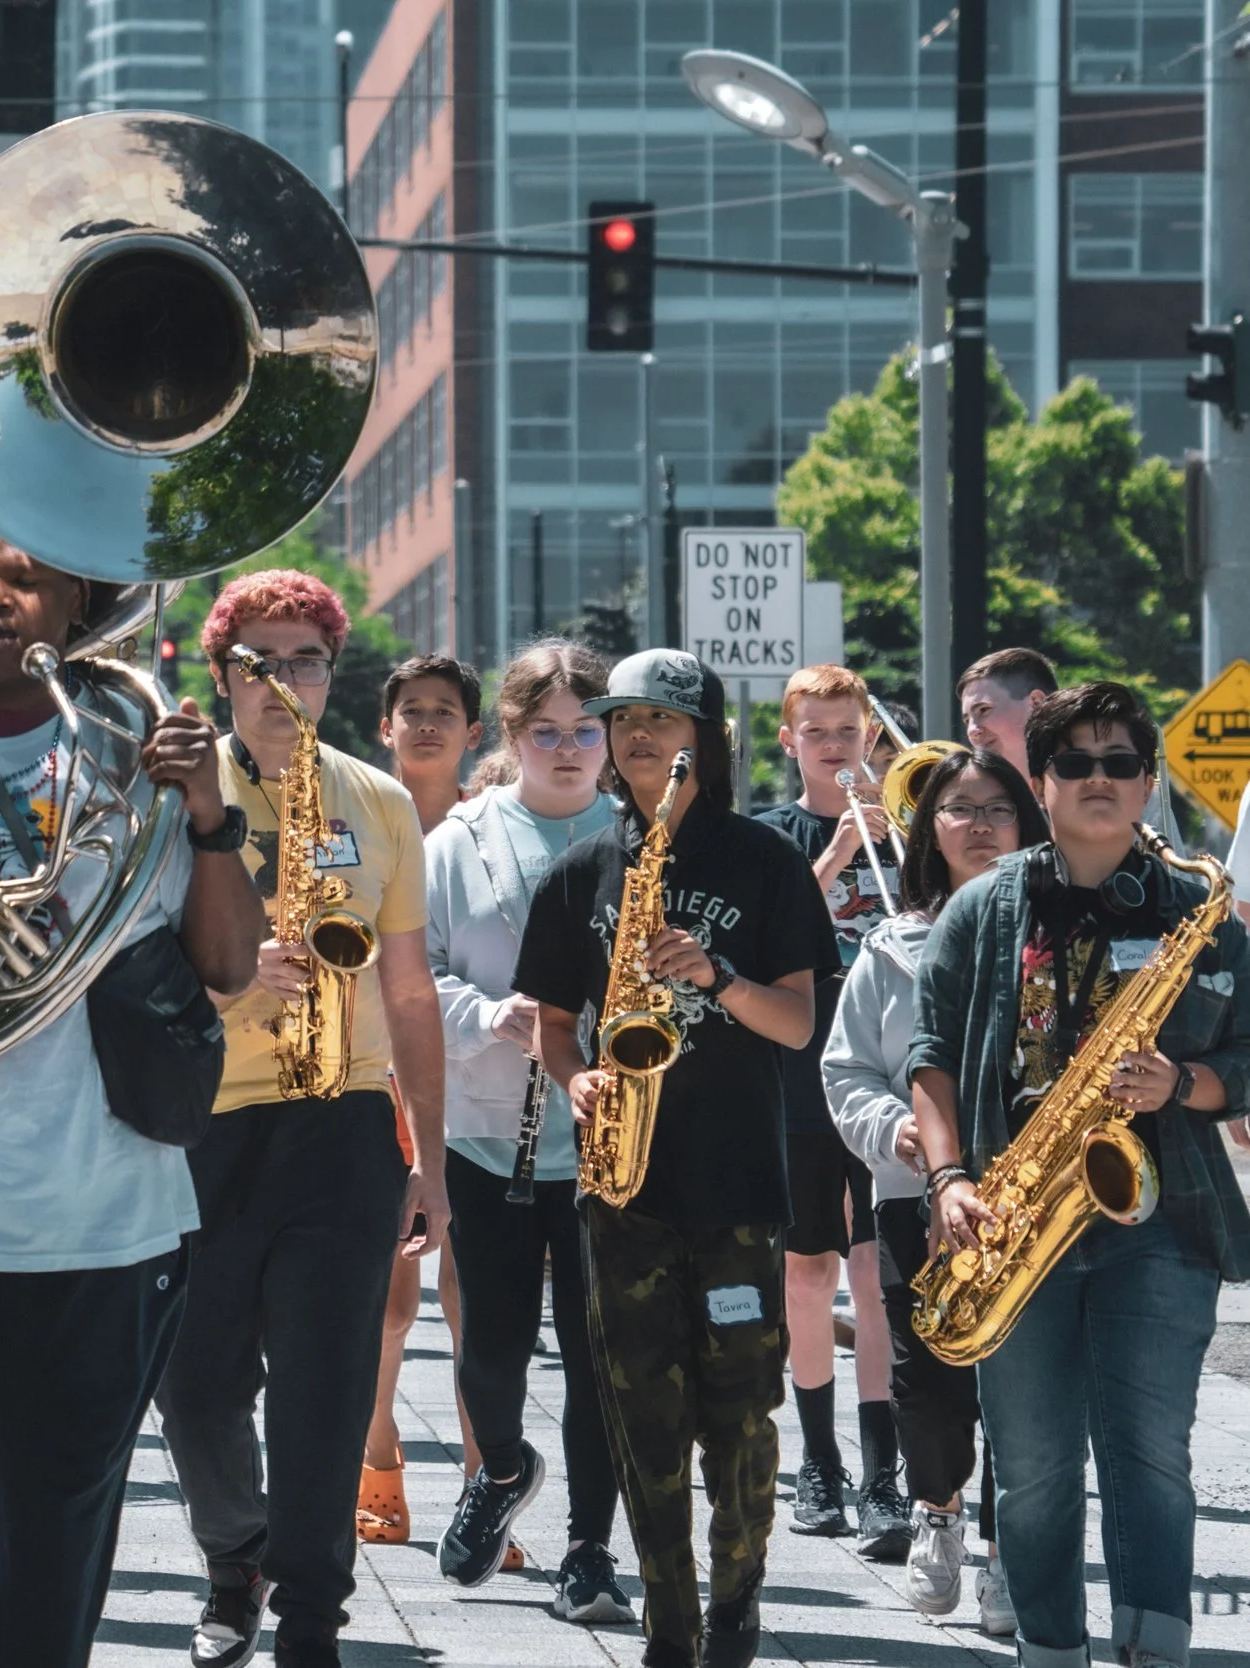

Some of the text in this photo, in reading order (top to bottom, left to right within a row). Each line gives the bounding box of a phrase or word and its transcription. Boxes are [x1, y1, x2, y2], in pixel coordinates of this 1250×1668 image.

[696, 542, 792, 568] DO NOT
[711, 575, 778, 600] STOP
[726, 607, 761, 632] ON
[694, 639, 796, 666] TRACKS
[1191, 768, 1235, 784] LOOK
[661, 889, 742, 930] DIEGO
[713, 1300, 752, 1313] Tavira
